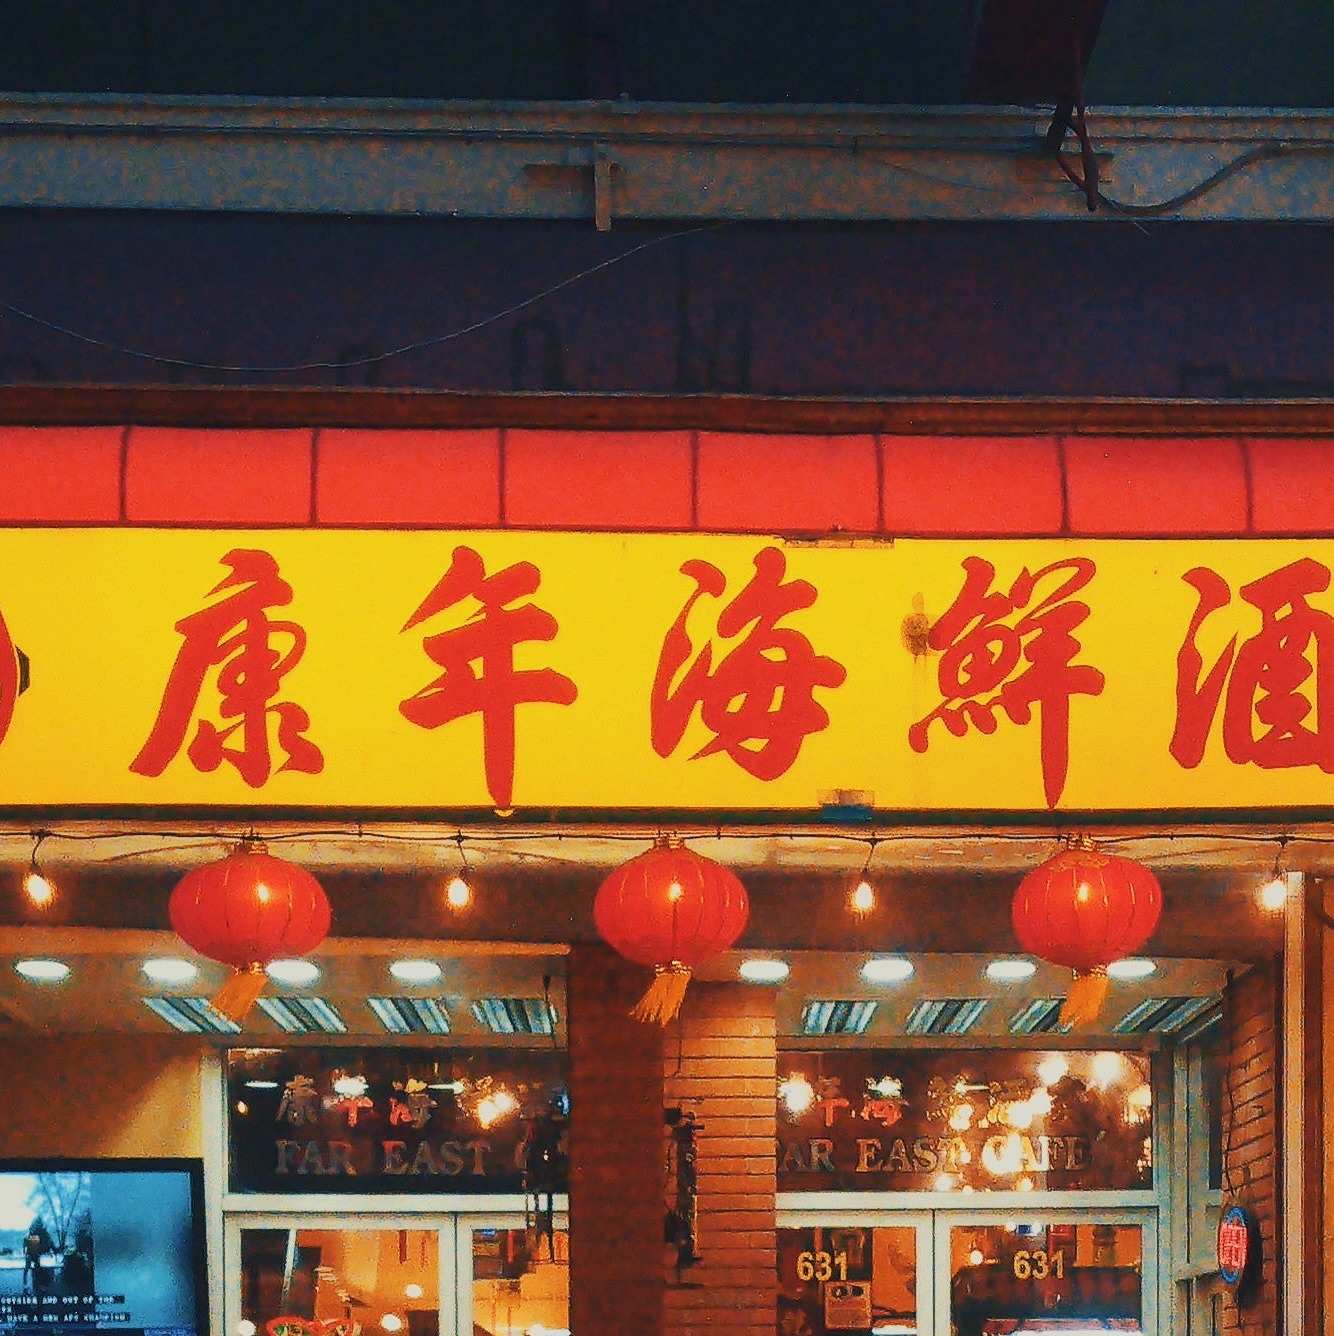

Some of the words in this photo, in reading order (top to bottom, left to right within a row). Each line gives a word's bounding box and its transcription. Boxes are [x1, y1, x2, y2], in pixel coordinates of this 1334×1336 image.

[275, 1139, 359, 1176] FAR
[382, 1139, 491, 1176] EAST
[774, 1136, 836, 1173] AR
[855, 1135, 965, 1173] EAST
[796, 1251, 849, 1281] 631
[1013, 1250, 1065, 1280] 631
